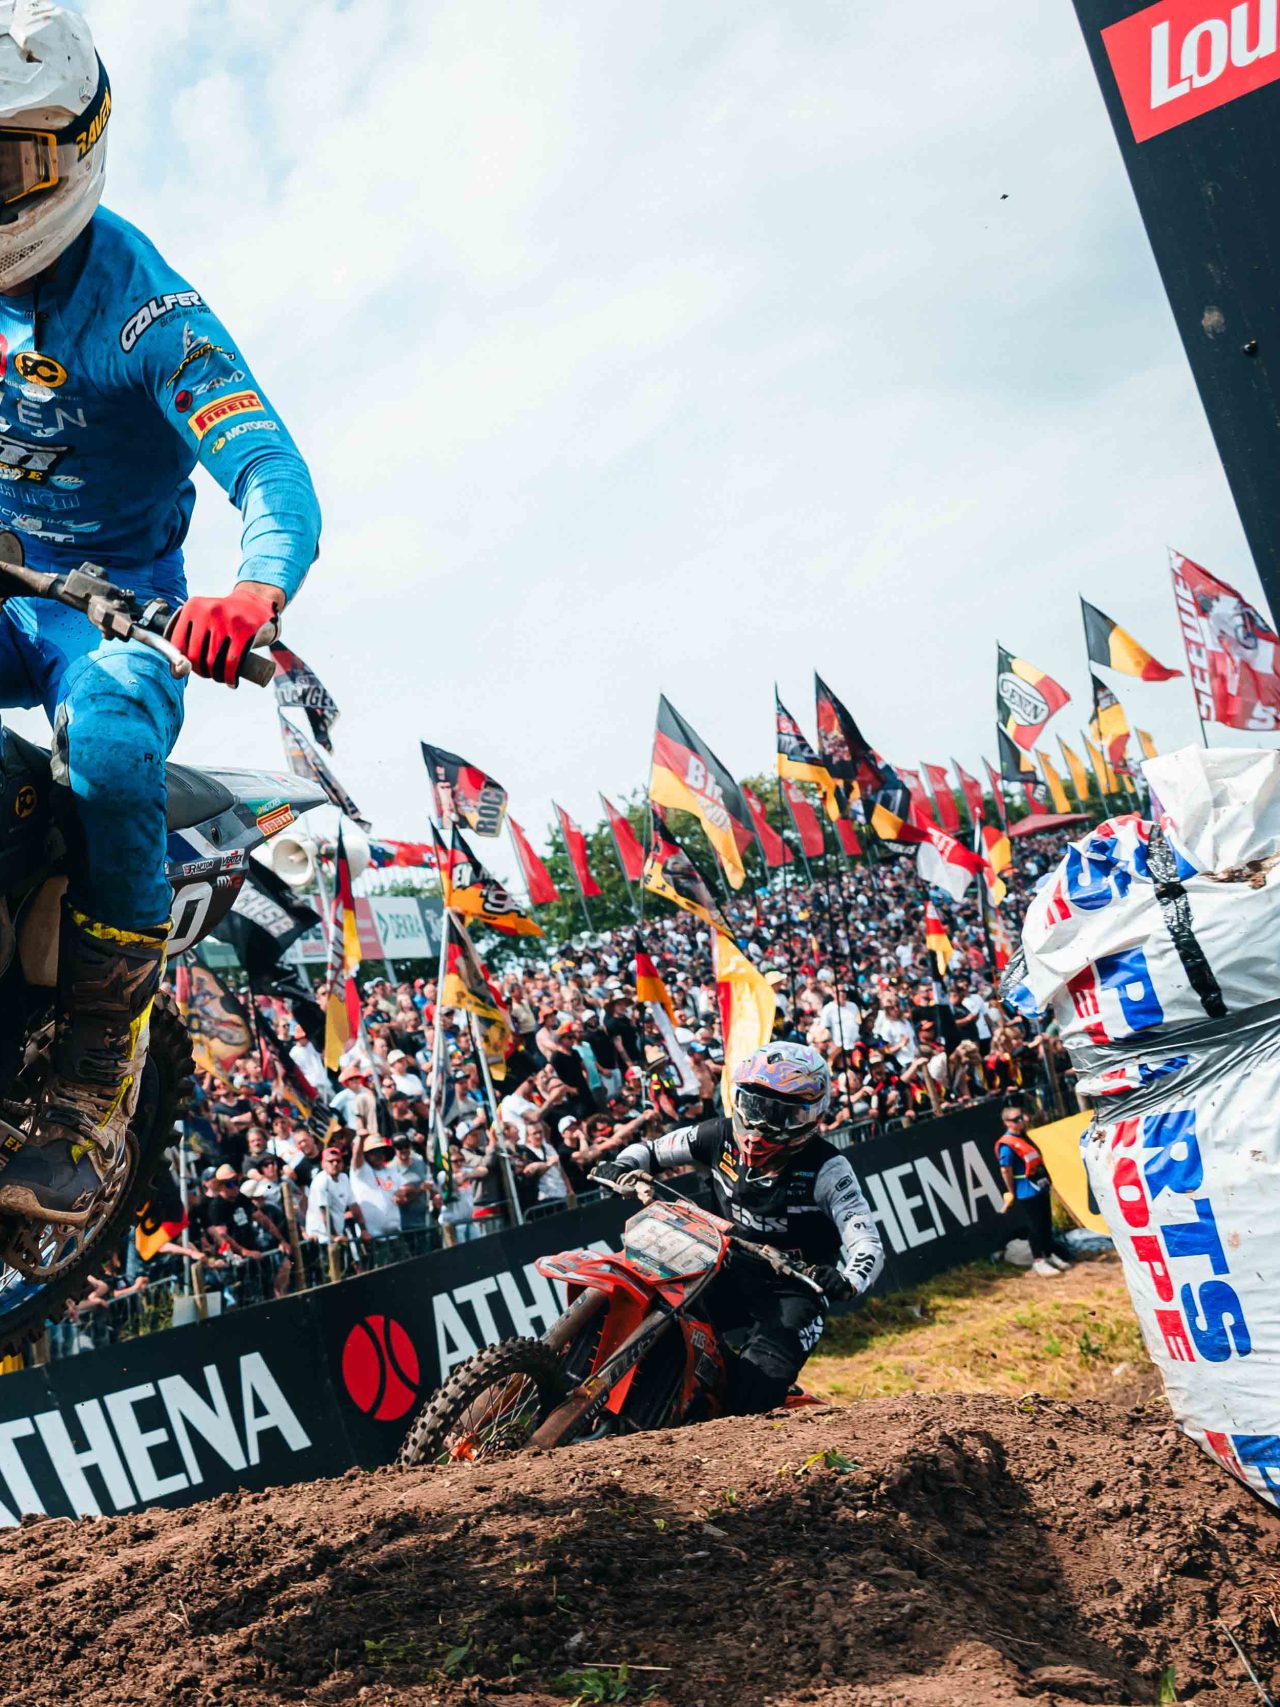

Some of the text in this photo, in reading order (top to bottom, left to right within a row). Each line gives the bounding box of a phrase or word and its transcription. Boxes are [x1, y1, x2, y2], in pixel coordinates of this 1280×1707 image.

[121, 290, 201, 351] GALFER
[225, 420, 280, 442] MOTOREX
[852, 1139, 1005, 1258] HENA
[431, 1239, 615, 1386] ATH
